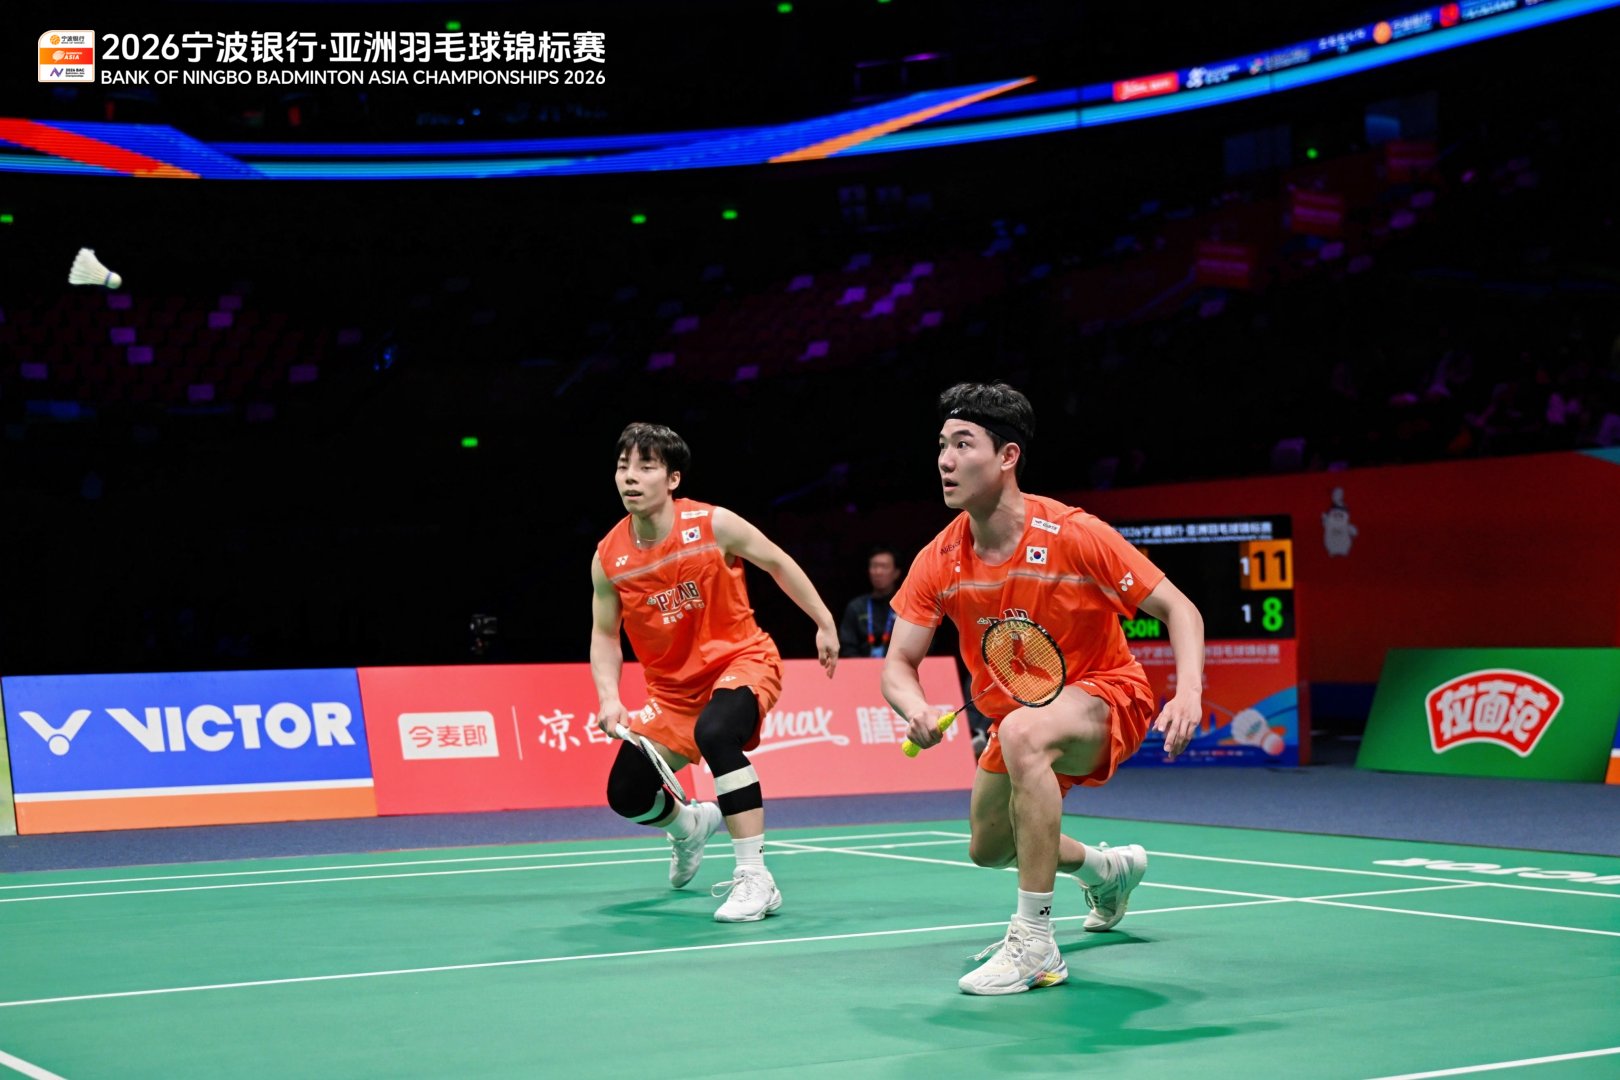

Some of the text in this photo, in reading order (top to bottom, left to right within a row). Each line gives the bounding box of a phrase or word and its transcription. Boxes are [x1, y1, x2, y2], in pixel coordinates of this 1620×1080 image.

[1240, 550, 1288, 583] 1 11
[1241, 596, 1283, 632] 1 8
[106, 702, 356, 752] VICTOR
[408, 725, 489, 748] 今麦郎
[538, 708, 640, 752] 凉白
